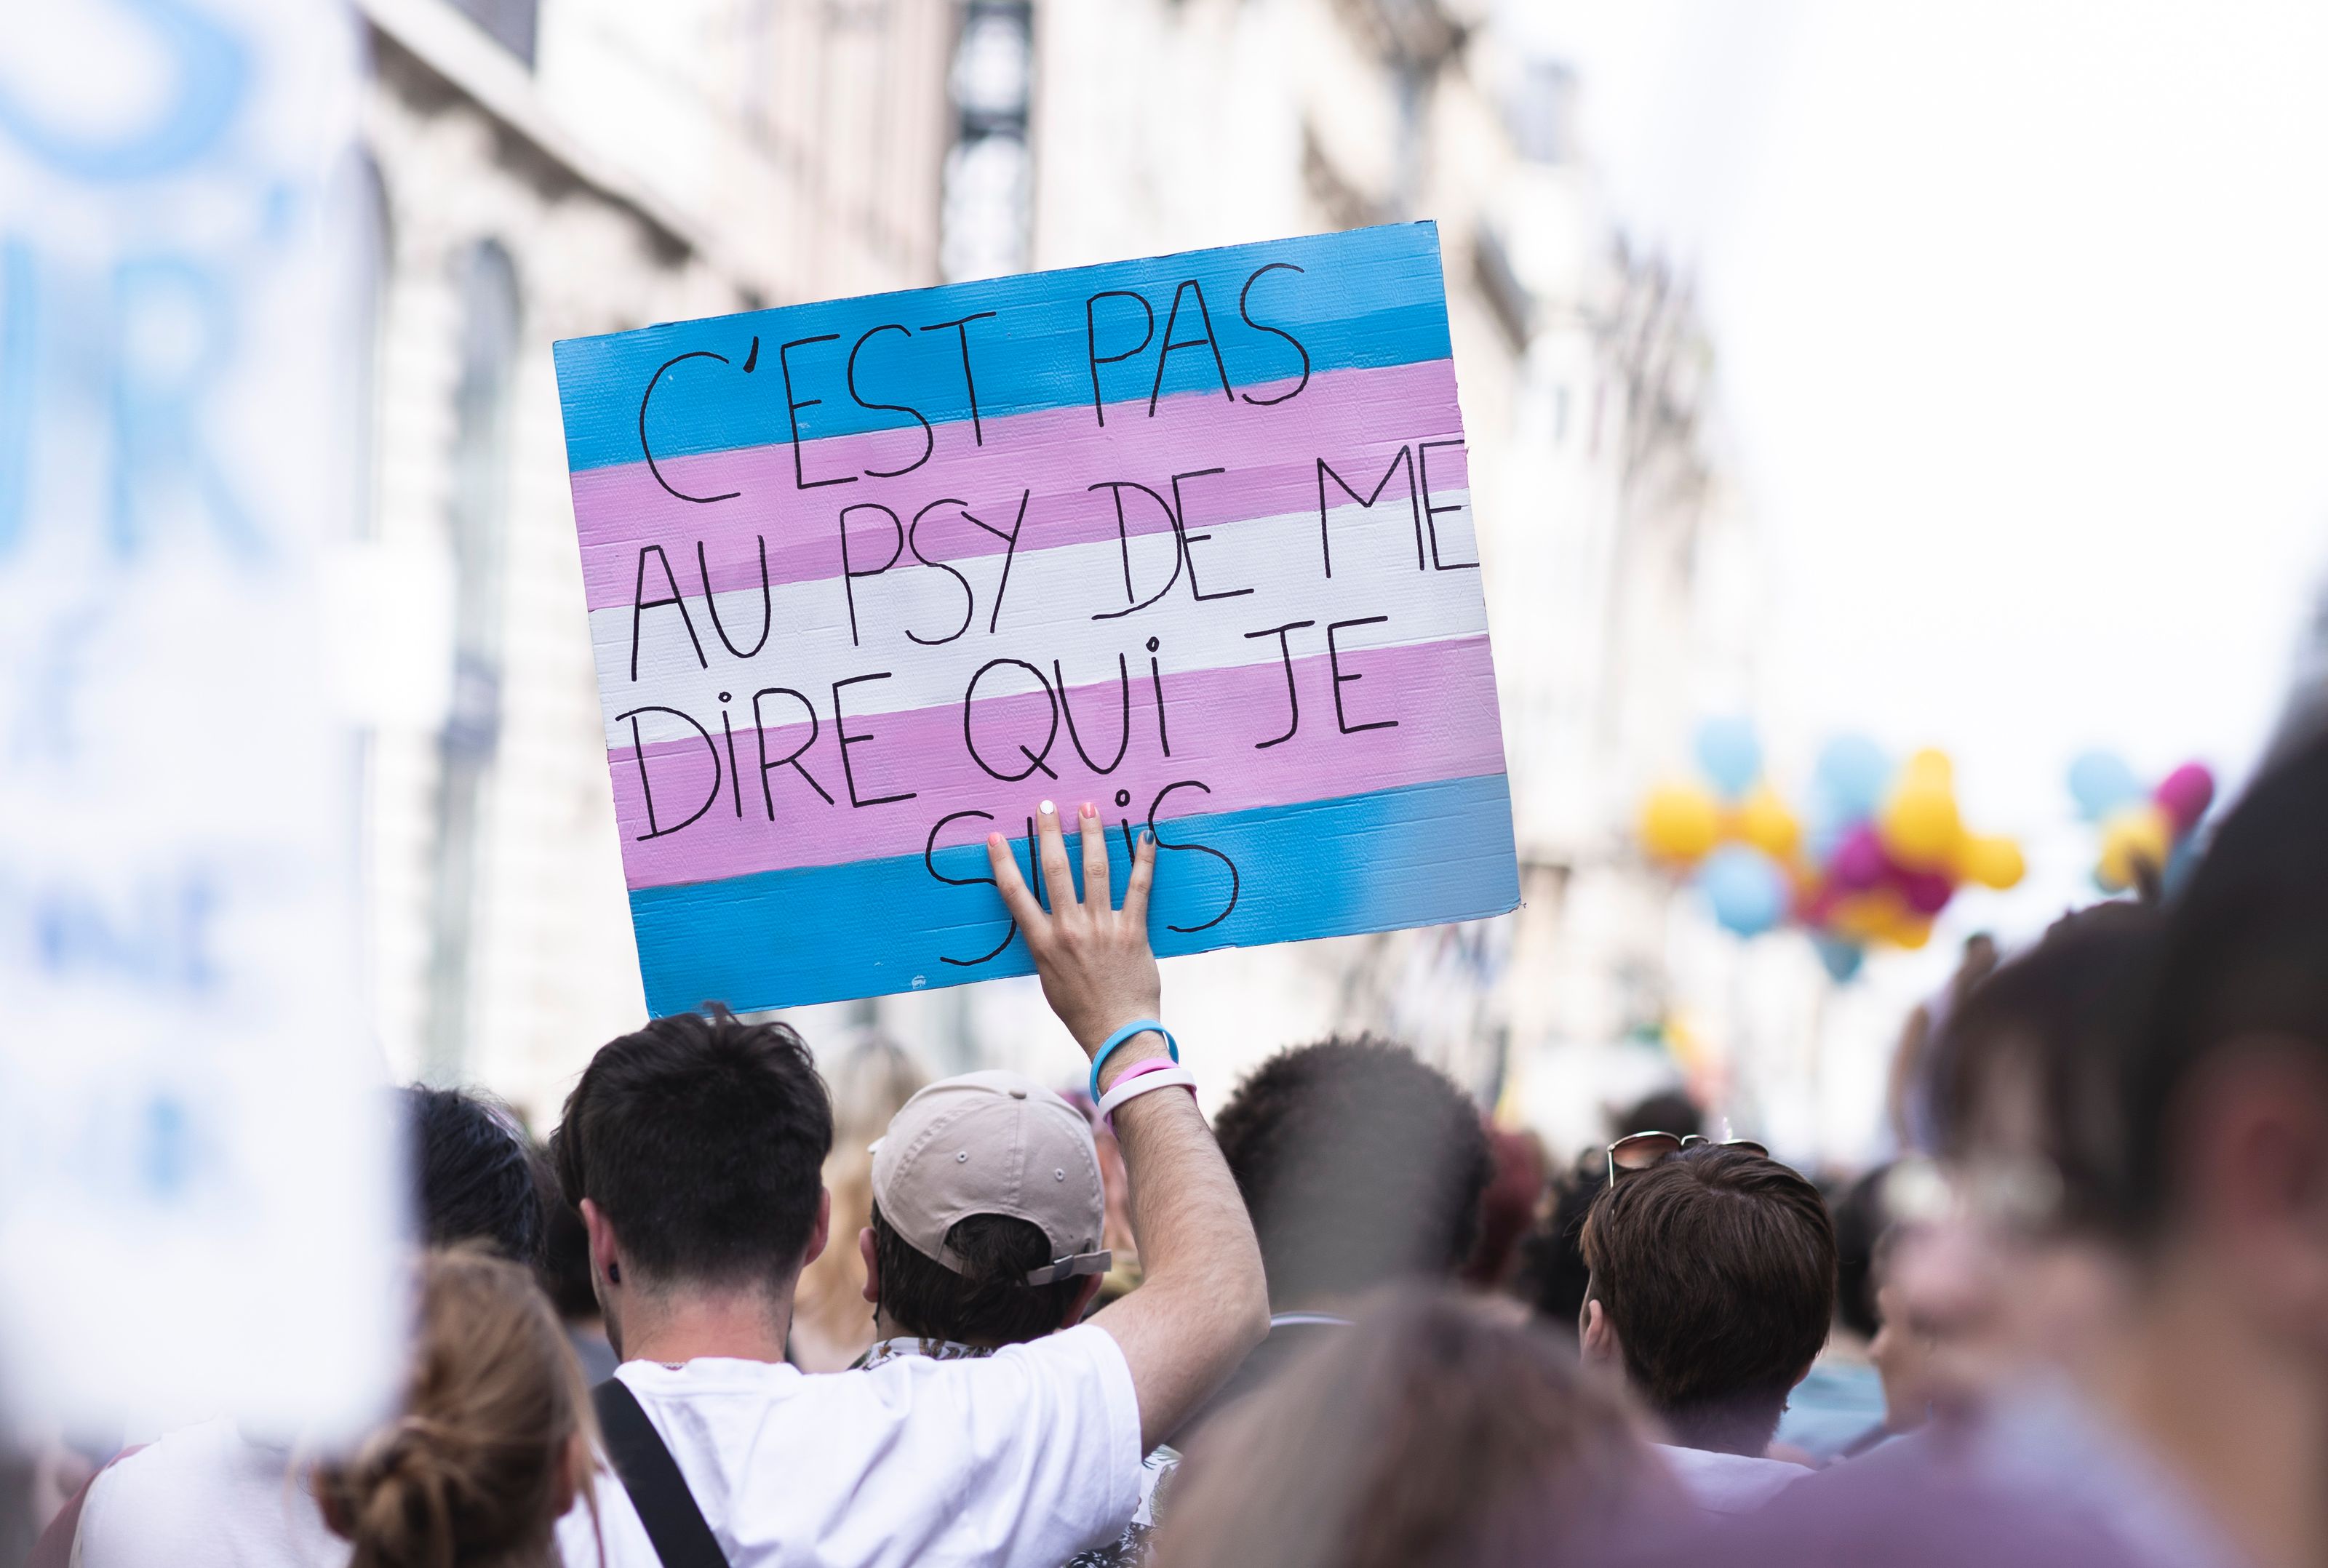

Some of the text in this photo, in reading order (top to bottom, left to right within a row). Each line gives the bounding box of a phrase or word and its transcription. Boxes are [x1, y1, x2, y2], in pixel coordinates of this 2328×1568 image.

[639, 263, 1310, 503] C'EST PAS
[631, 439, 1480, 682] AU PSY DE ME
[1243, 615, 1399, 749] JE
